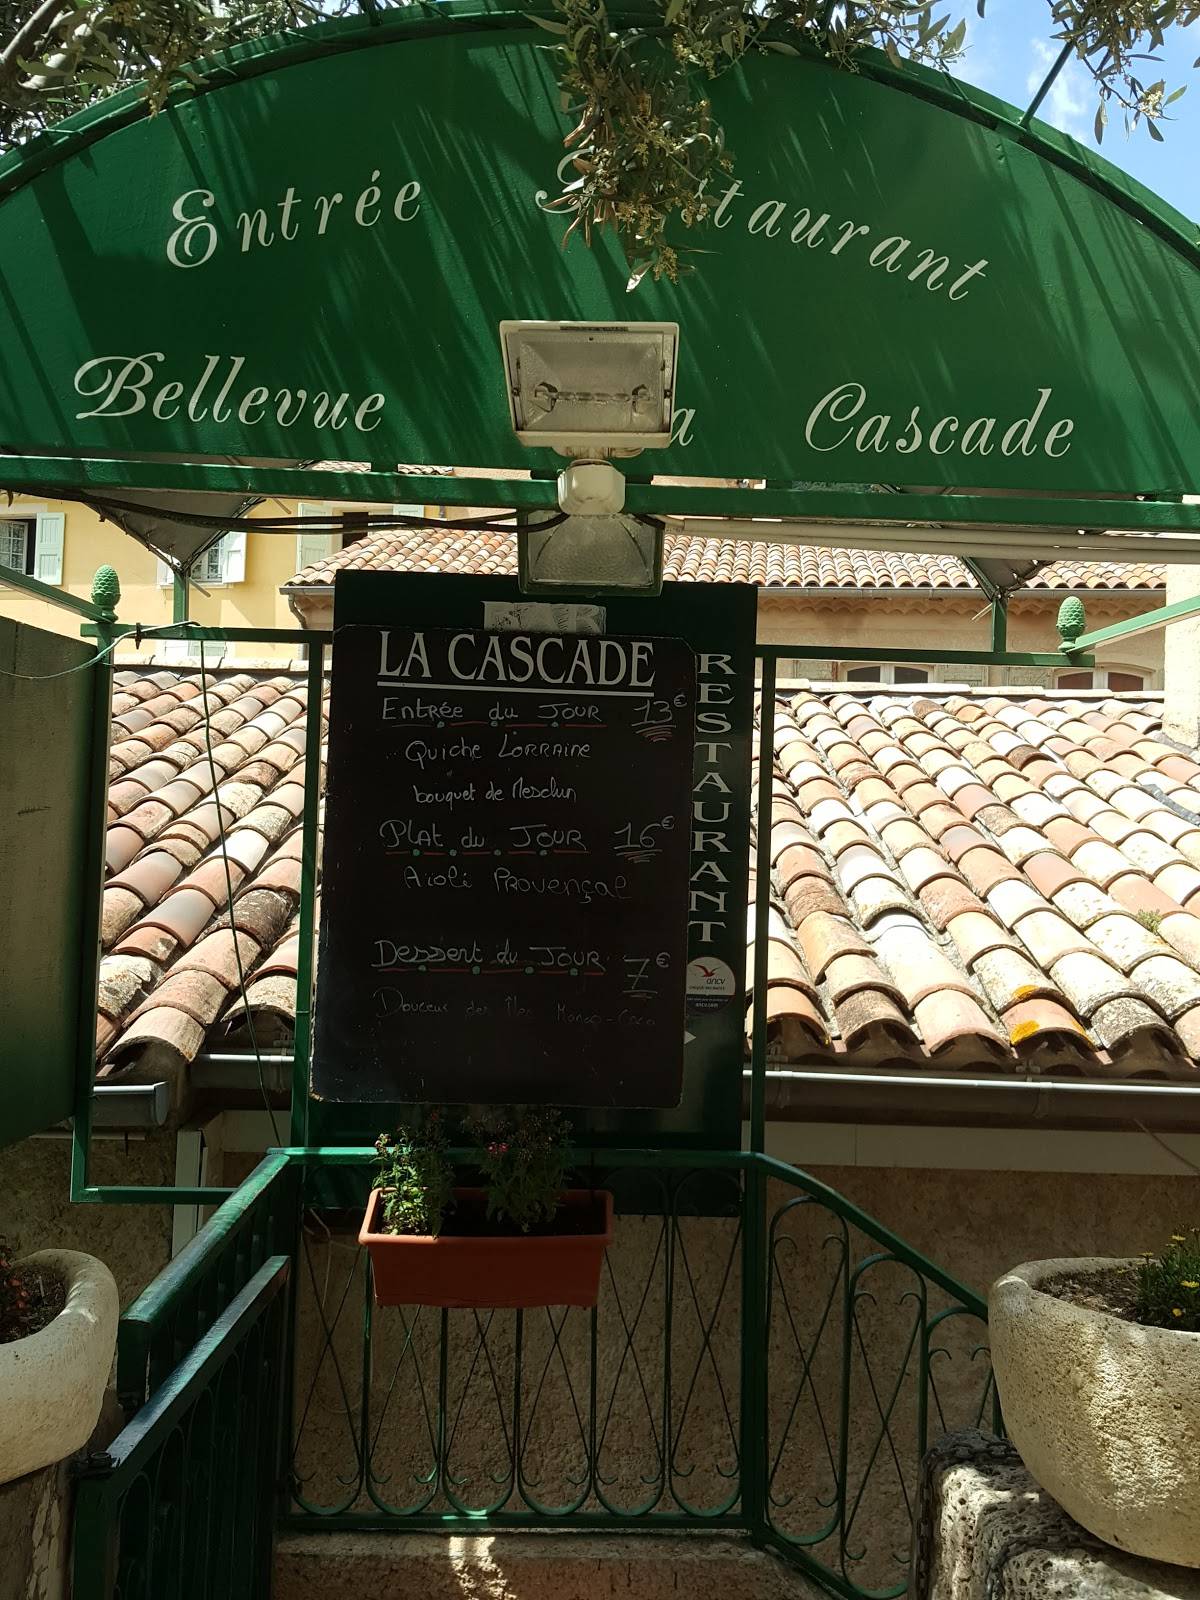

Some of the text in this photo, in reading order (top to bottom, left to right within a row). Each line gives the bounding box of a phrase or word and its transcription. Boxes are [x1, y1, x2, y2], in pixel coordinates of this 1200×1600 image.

[166, 169, 422, 268] Entrée
[74, 351, 386, 432] Bellevue
[804, 382, 1075, 457] Cascade
[377, 630, 656, 688] LA CASCADE
[489, 702, 519, 721] du
[405, 737, 483, 770] Quiche
[415, 783, 475, 812] bouquet
[485, 783, 505, 802] de
[688, 653, 737, 943] RESTAURANT
[461, 827, 485, 848] du
[496, 939, 519, 965] du
